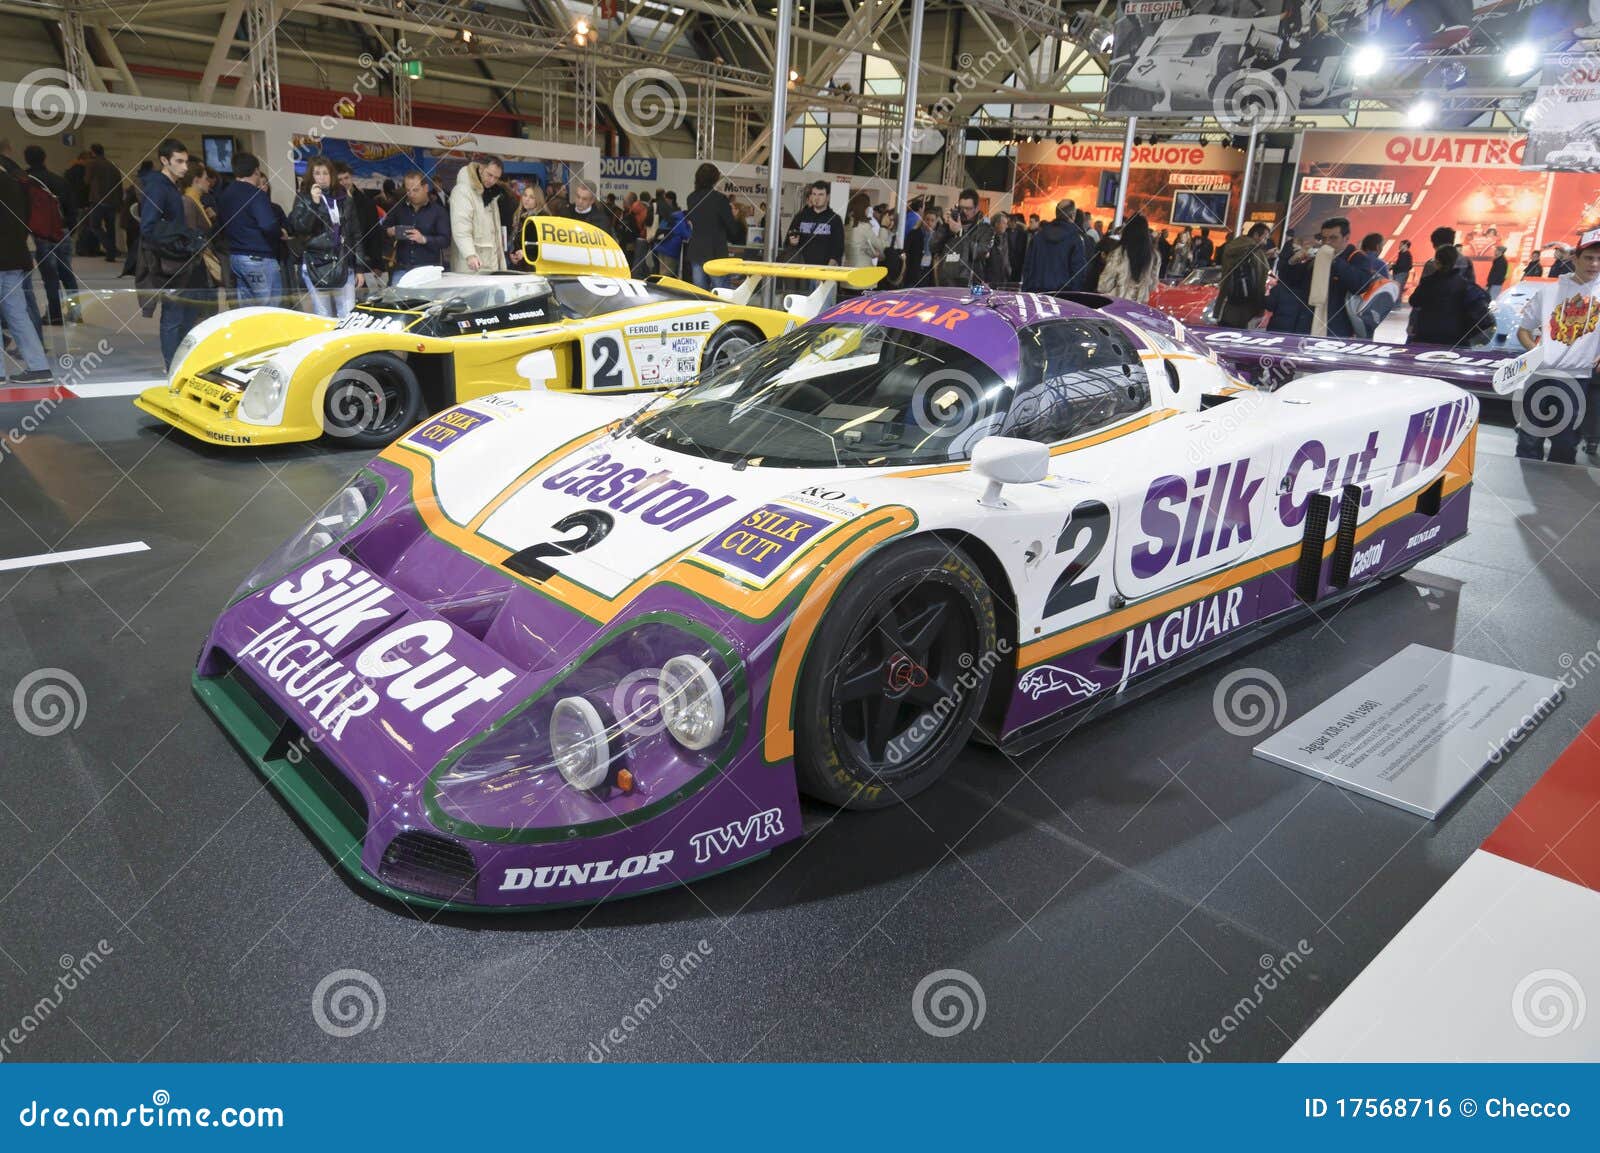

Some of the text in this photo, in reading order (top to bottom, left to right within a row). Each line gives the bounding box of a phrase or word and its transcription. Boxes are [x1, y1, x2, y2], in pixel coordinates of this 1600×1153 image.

[1140, 1, 1181, 12] REGINE
[1303, 178, 1394, 194] LE REGINE
[1348, 192, 1409, 206] di LE MANS
[541, 223, 607, 247] Renault
[475, 315, 500, 327] Pironi
[629, 320, 710, 334] FERODO CIBIE
[822, 300, 970, 332] JAGUAR
[590, 336, 623, 388] 2
[1204, 331, 1512, 368] Cut Silk Cut
[220, 390, 236, 403] V6
[206, 430, 251, 443] MICHELIN
[421, 424, 458, 443] CUT
[440, 411, 480, 431] SILK
[542, 452, 738, 532] Castrol
[1131, 430, 1381, 579] Silk Cut
[742, 509, 813, 543] SILK
[1406, 525, 1441, 549] DUNLOP
[500, 508, 615, 585] 2
[721, 530, 783, 565] CUT
[1042, 499, 1111, 619] 2
[1349, 539, 1386, 579] Castrol
[269, 558, 517, 733] Silk Cut
[1117, 586, 1244, 695] JAGUAR
[236, 616, 380, 742] JAGUAR
[1298, 735, 1331, 755] Jaguar
[499, 807, 785, 892] DUNLOP TWR
